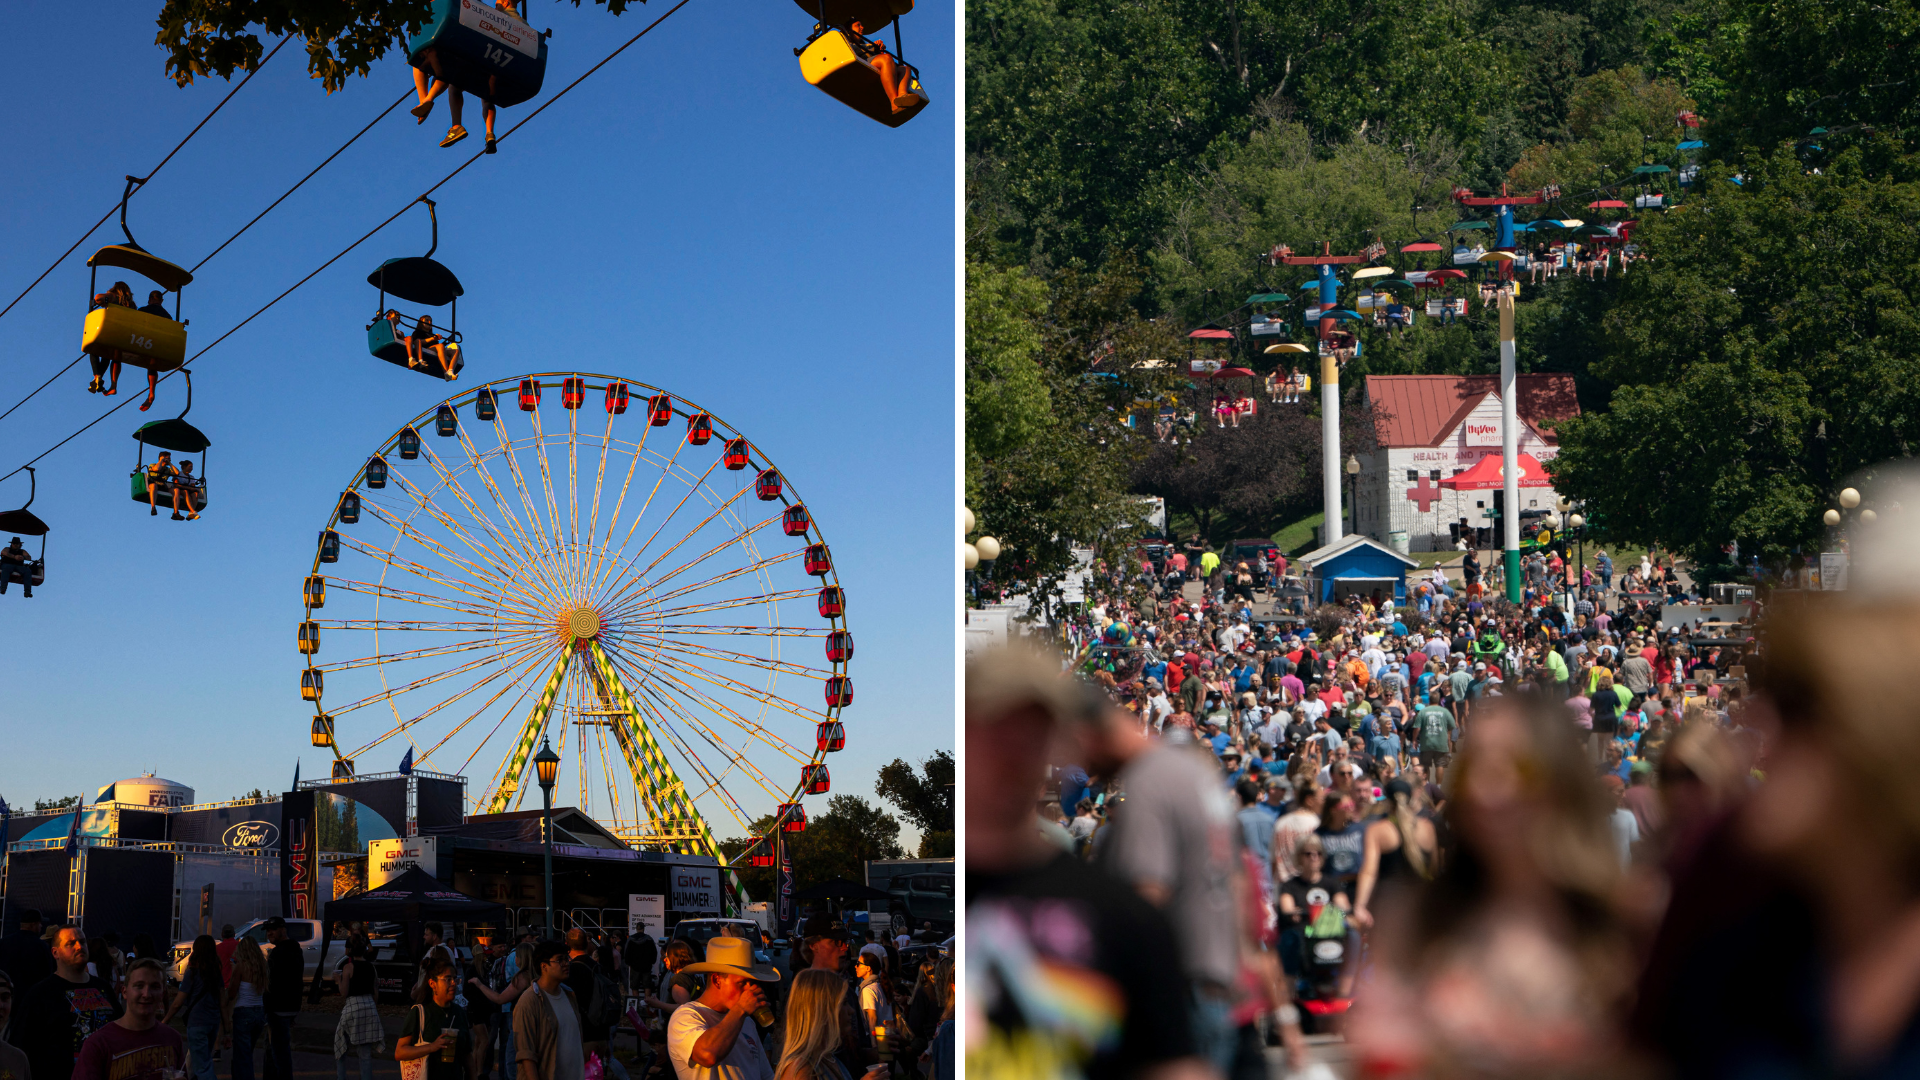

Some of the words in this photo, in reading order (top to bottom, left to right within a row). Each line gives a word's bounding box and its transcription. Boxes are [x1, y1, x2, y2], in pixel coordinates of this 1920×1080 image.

[484, 42, 514, 68] 147
[1322, 264, 1330, 276] 3
[130, 333, 153, 350] 146
[1413, 452, 1448, 461] HEALTH
[1454, 451, 1474, 460] AND
[1535, 451, 1560, 460] CENT
[149, 793, 186, 806] FAIR
[232, 825, 269, 847] Ford
[385, 848, 420, 859] GMC
[289, 818, 309, 919] GMC
[380, 860, 416, 872] HUMMER
[677, 875, 712, 888] GMC
[780, 839, 793, 921] GMC
[424, 890, 467, 899] GMC
[481, 883, 535, 900] GMC
[672, 891, 709, 907] HUMMER
